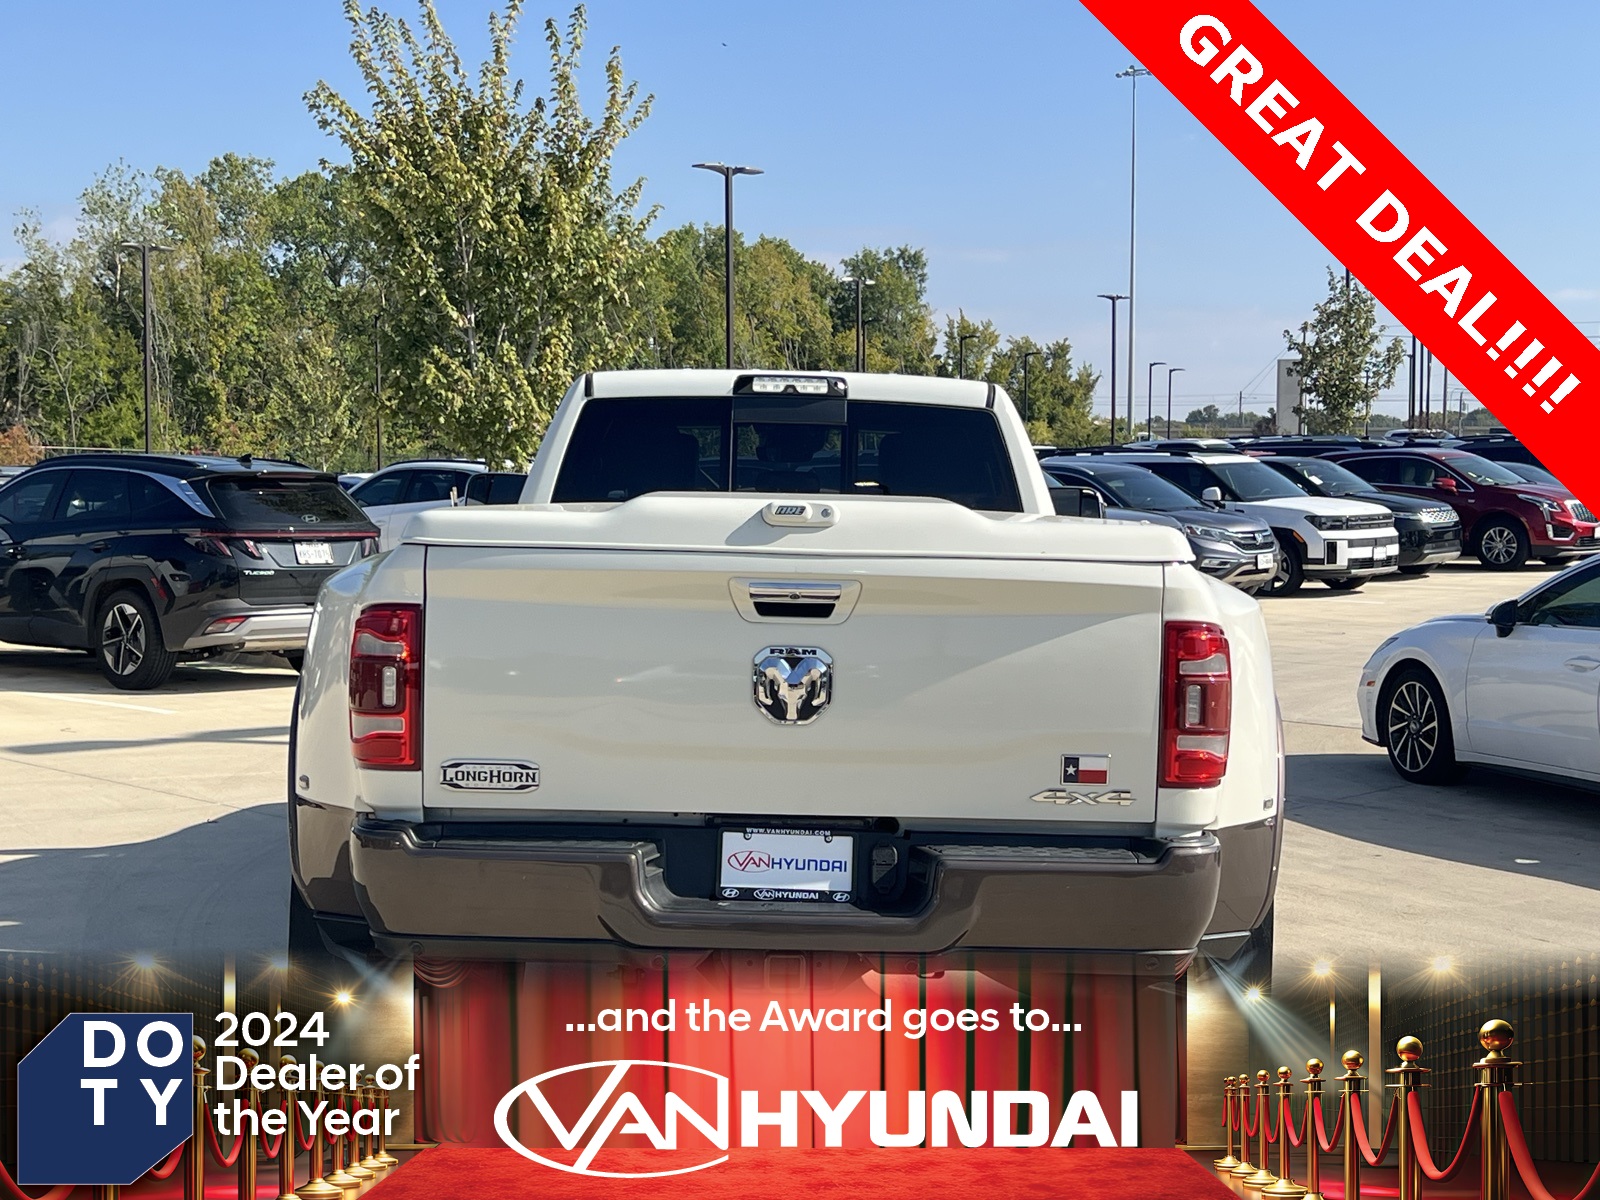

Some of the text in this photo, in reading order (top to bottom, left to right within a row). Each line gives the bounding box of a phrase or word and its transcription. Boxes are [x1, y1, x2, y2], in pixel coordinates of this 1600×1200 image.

[769, 647, 818, 656] RAM
[441, 768, 538, 784] LONGHORN
[1029, 788, 1137, 806] 4x4
[745, 827, 832, 837] WWW.VANHYUNDAI.COM
